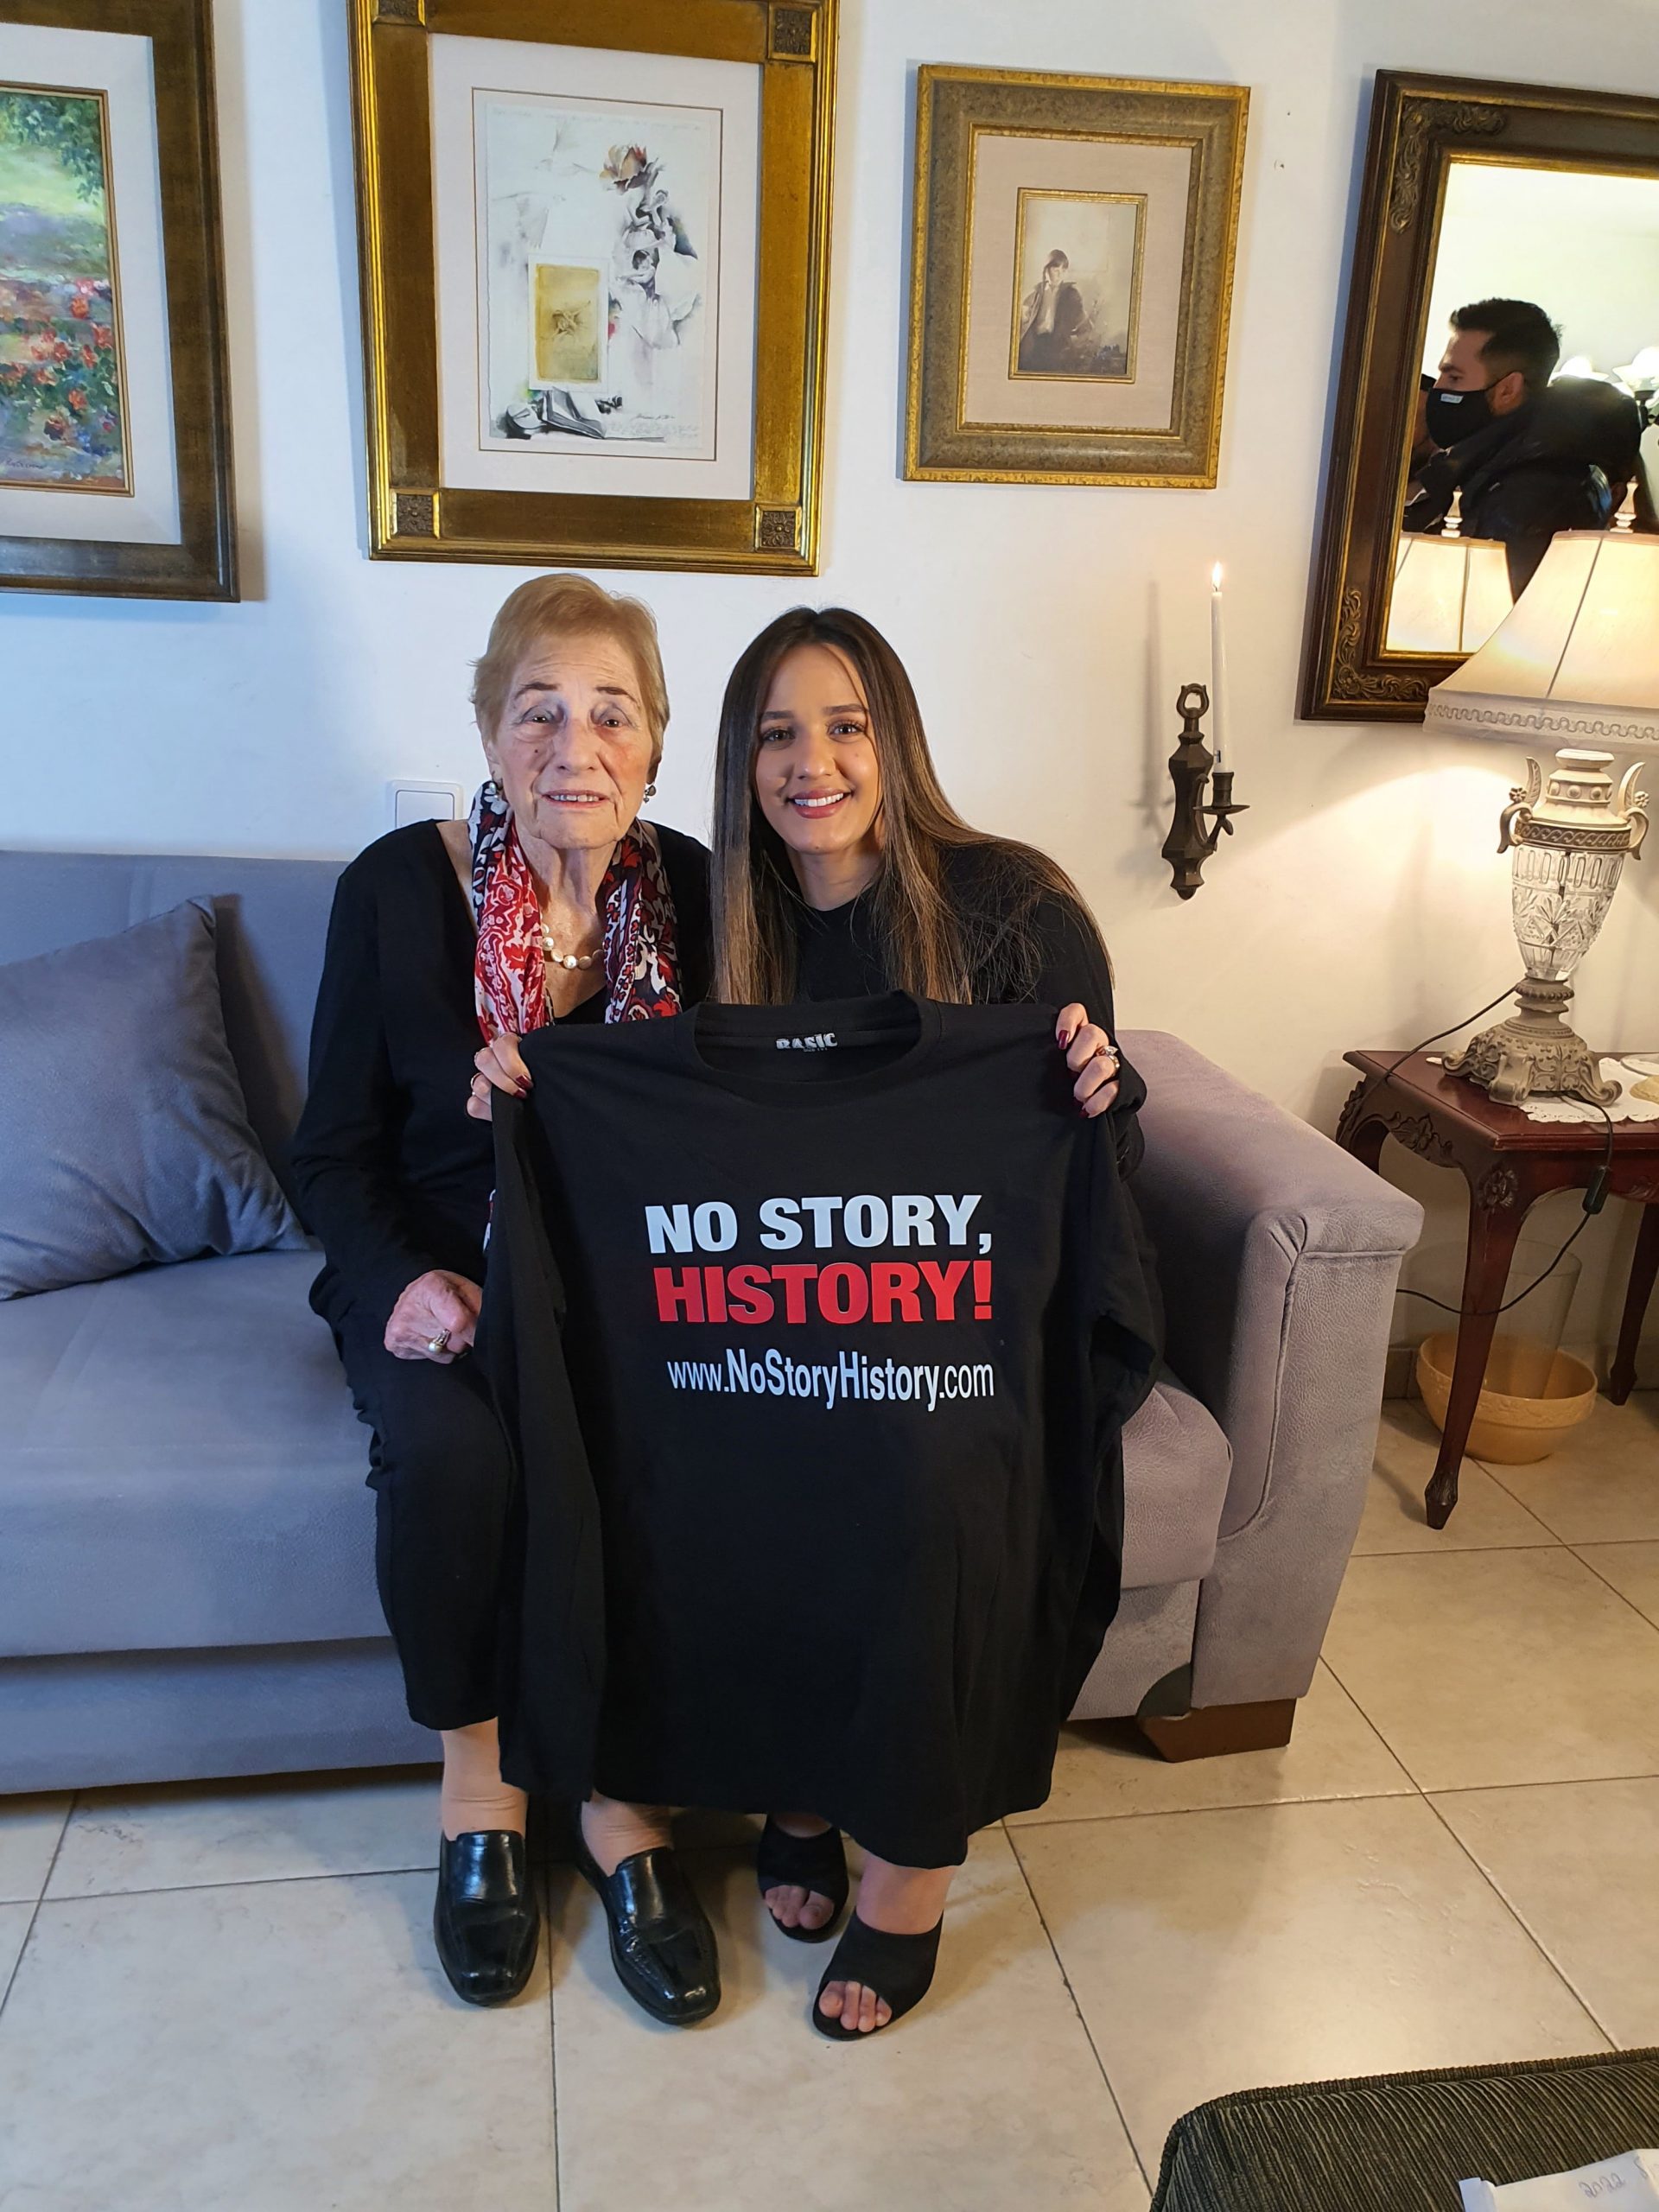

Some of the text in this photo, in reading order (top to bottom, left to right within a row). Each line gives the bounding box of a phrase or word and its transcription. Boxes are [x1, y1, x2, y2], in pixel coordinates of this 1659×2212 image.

[645, 1194, 992, 1255] NO STORY,
[653, 1260, 993, 1325] HISTORY!
[666, 1348, 995, 1412] www.NoStoryHistory.com
